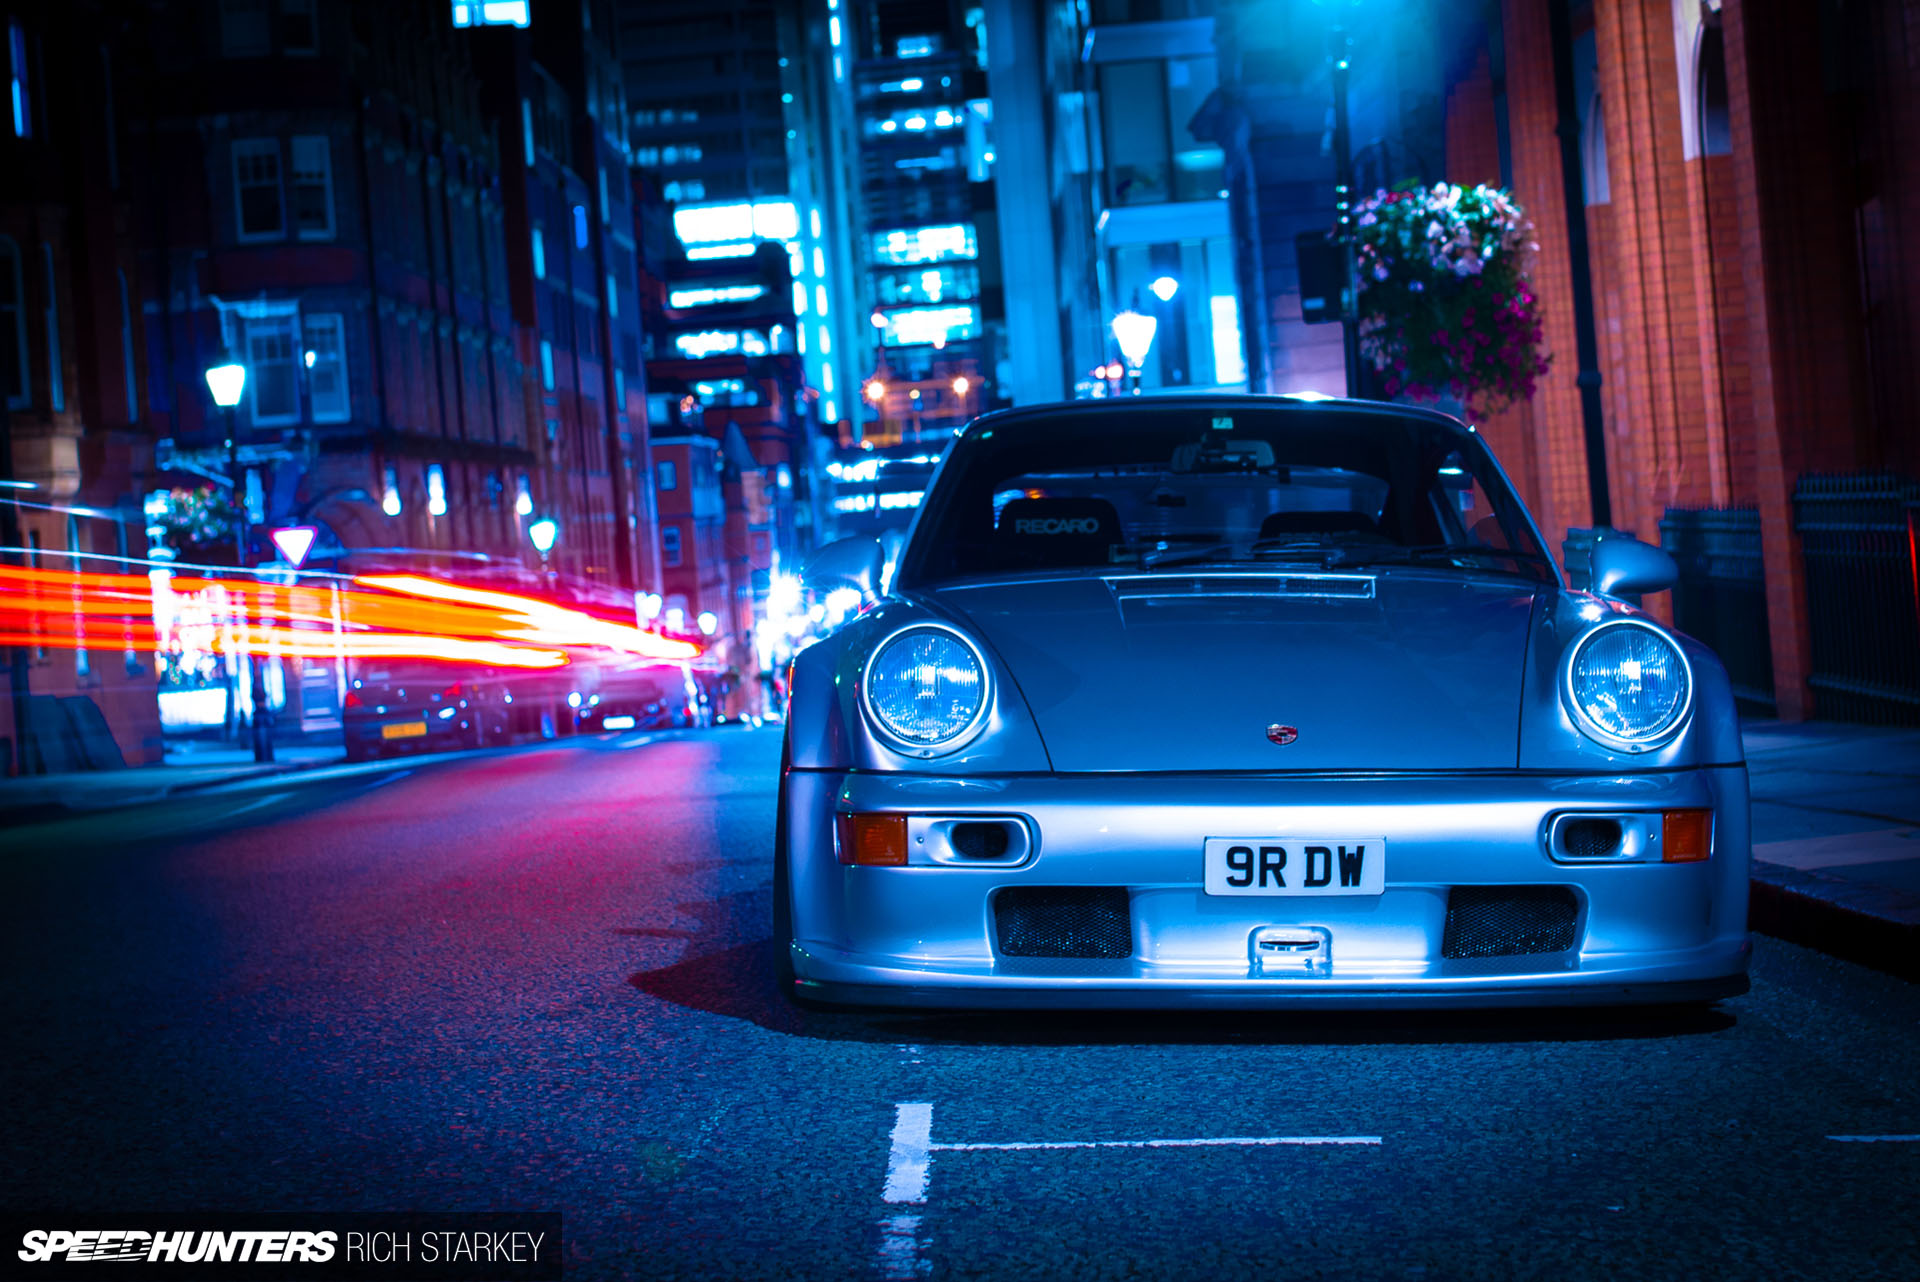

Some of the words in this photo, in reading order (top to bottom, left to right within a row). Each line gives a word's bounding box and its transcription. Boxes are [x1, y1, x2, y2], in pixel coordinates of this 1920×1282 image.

[1015, 518, 1099, 535] RECARO
[1226, 846, 1287, 888] 9R
[1304, 845, 1365, 888] DW
